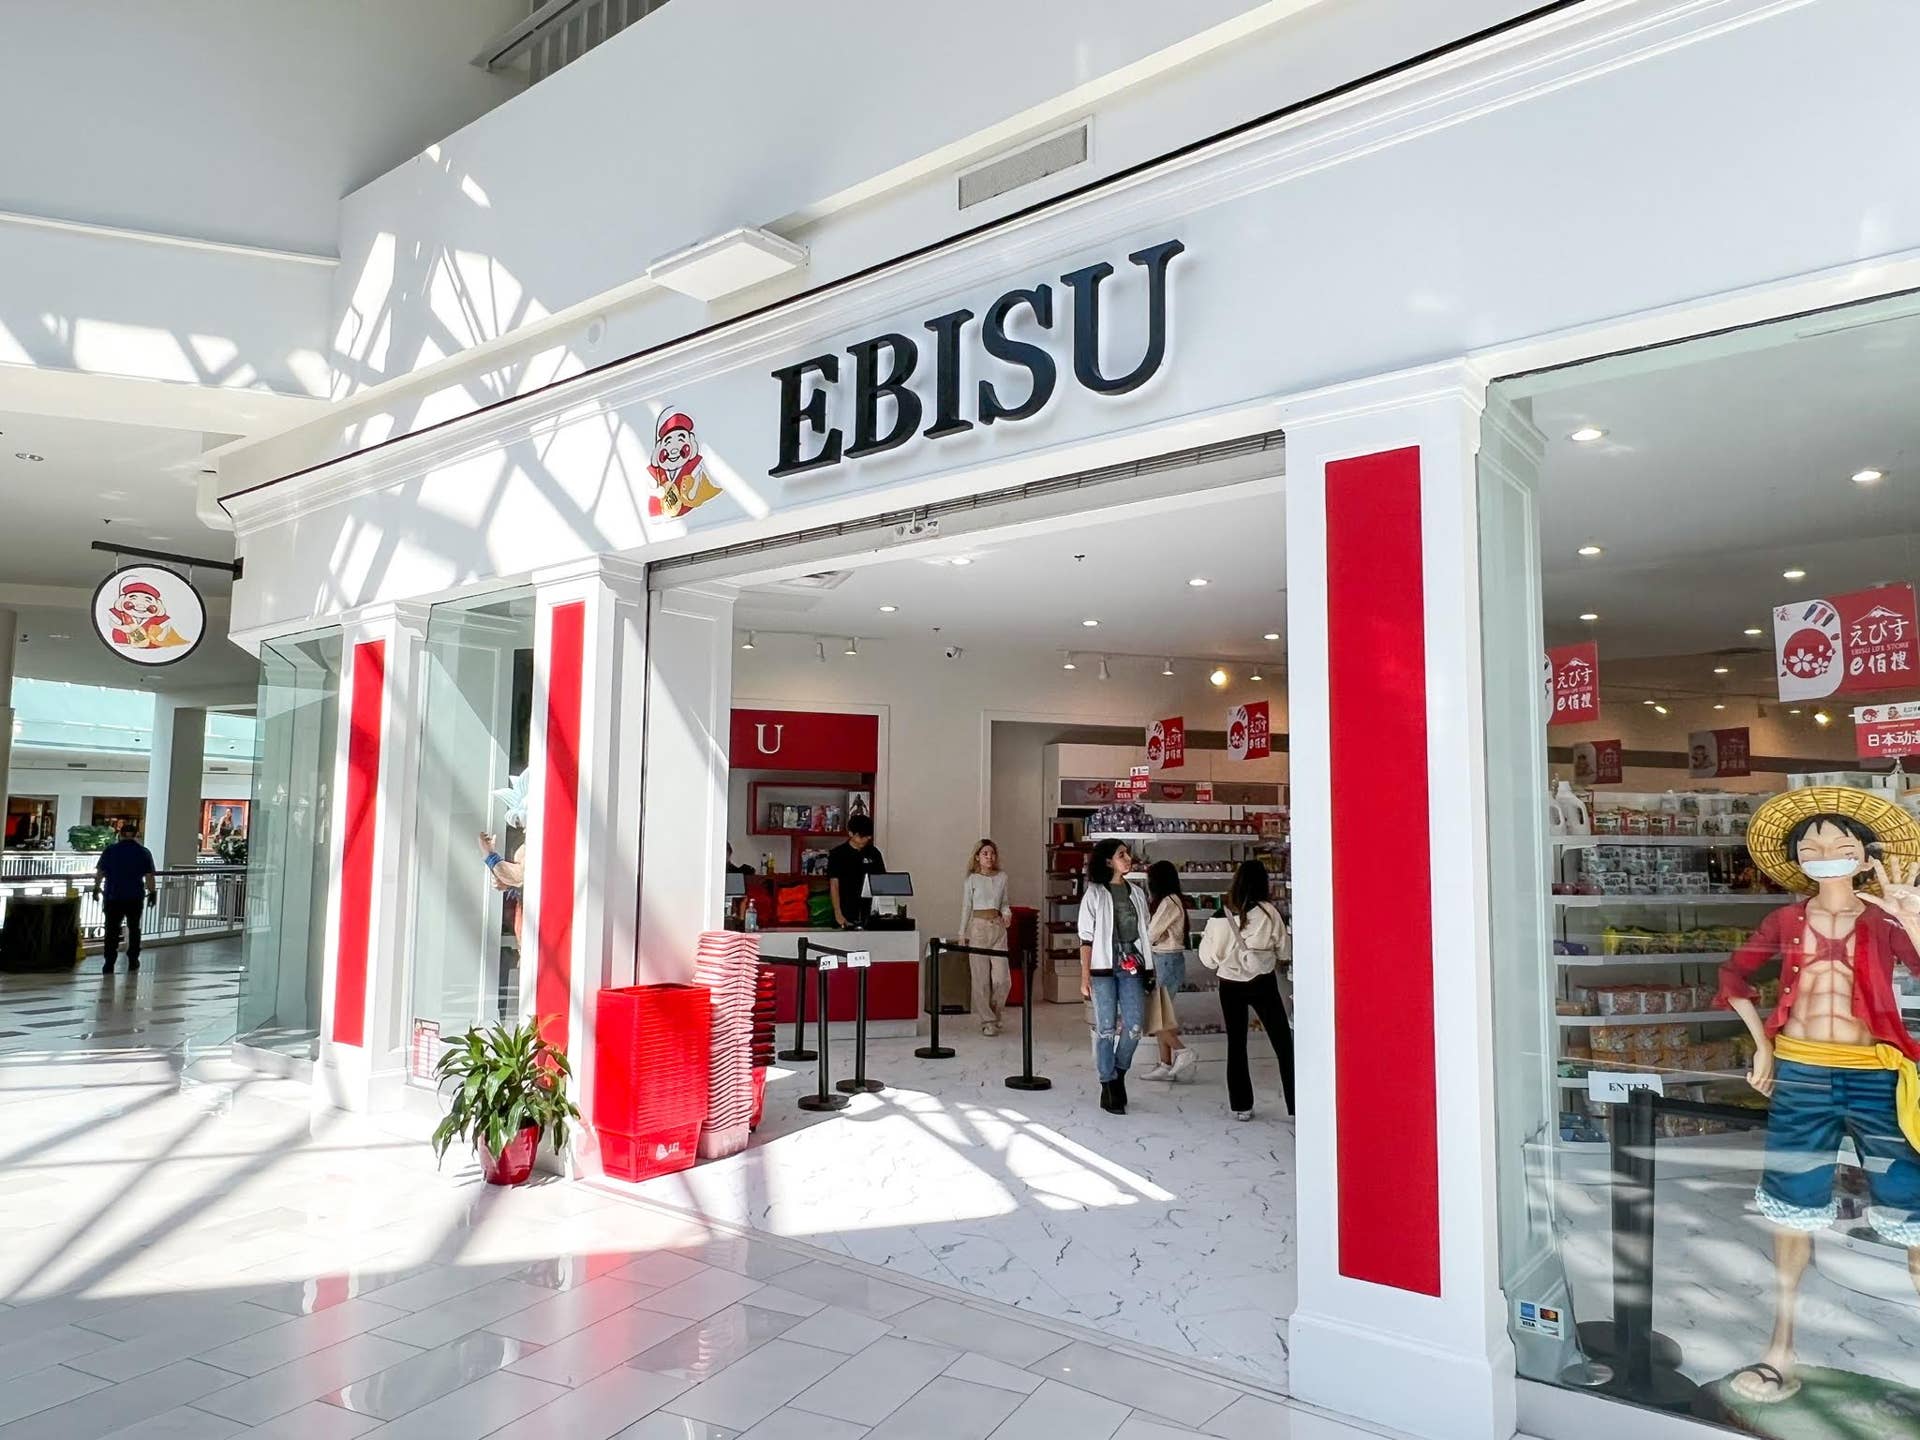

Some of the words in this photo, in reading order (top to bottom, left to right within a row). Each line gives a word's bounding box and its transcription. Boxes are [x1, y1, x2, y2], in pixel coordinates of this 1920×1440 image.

[768, 239, 1185, 478] EBISU
[1850, 618, 1910, 647] えびす
[1556, 668, 1593, 689] えびす
[755, 724, 784, 754] U
